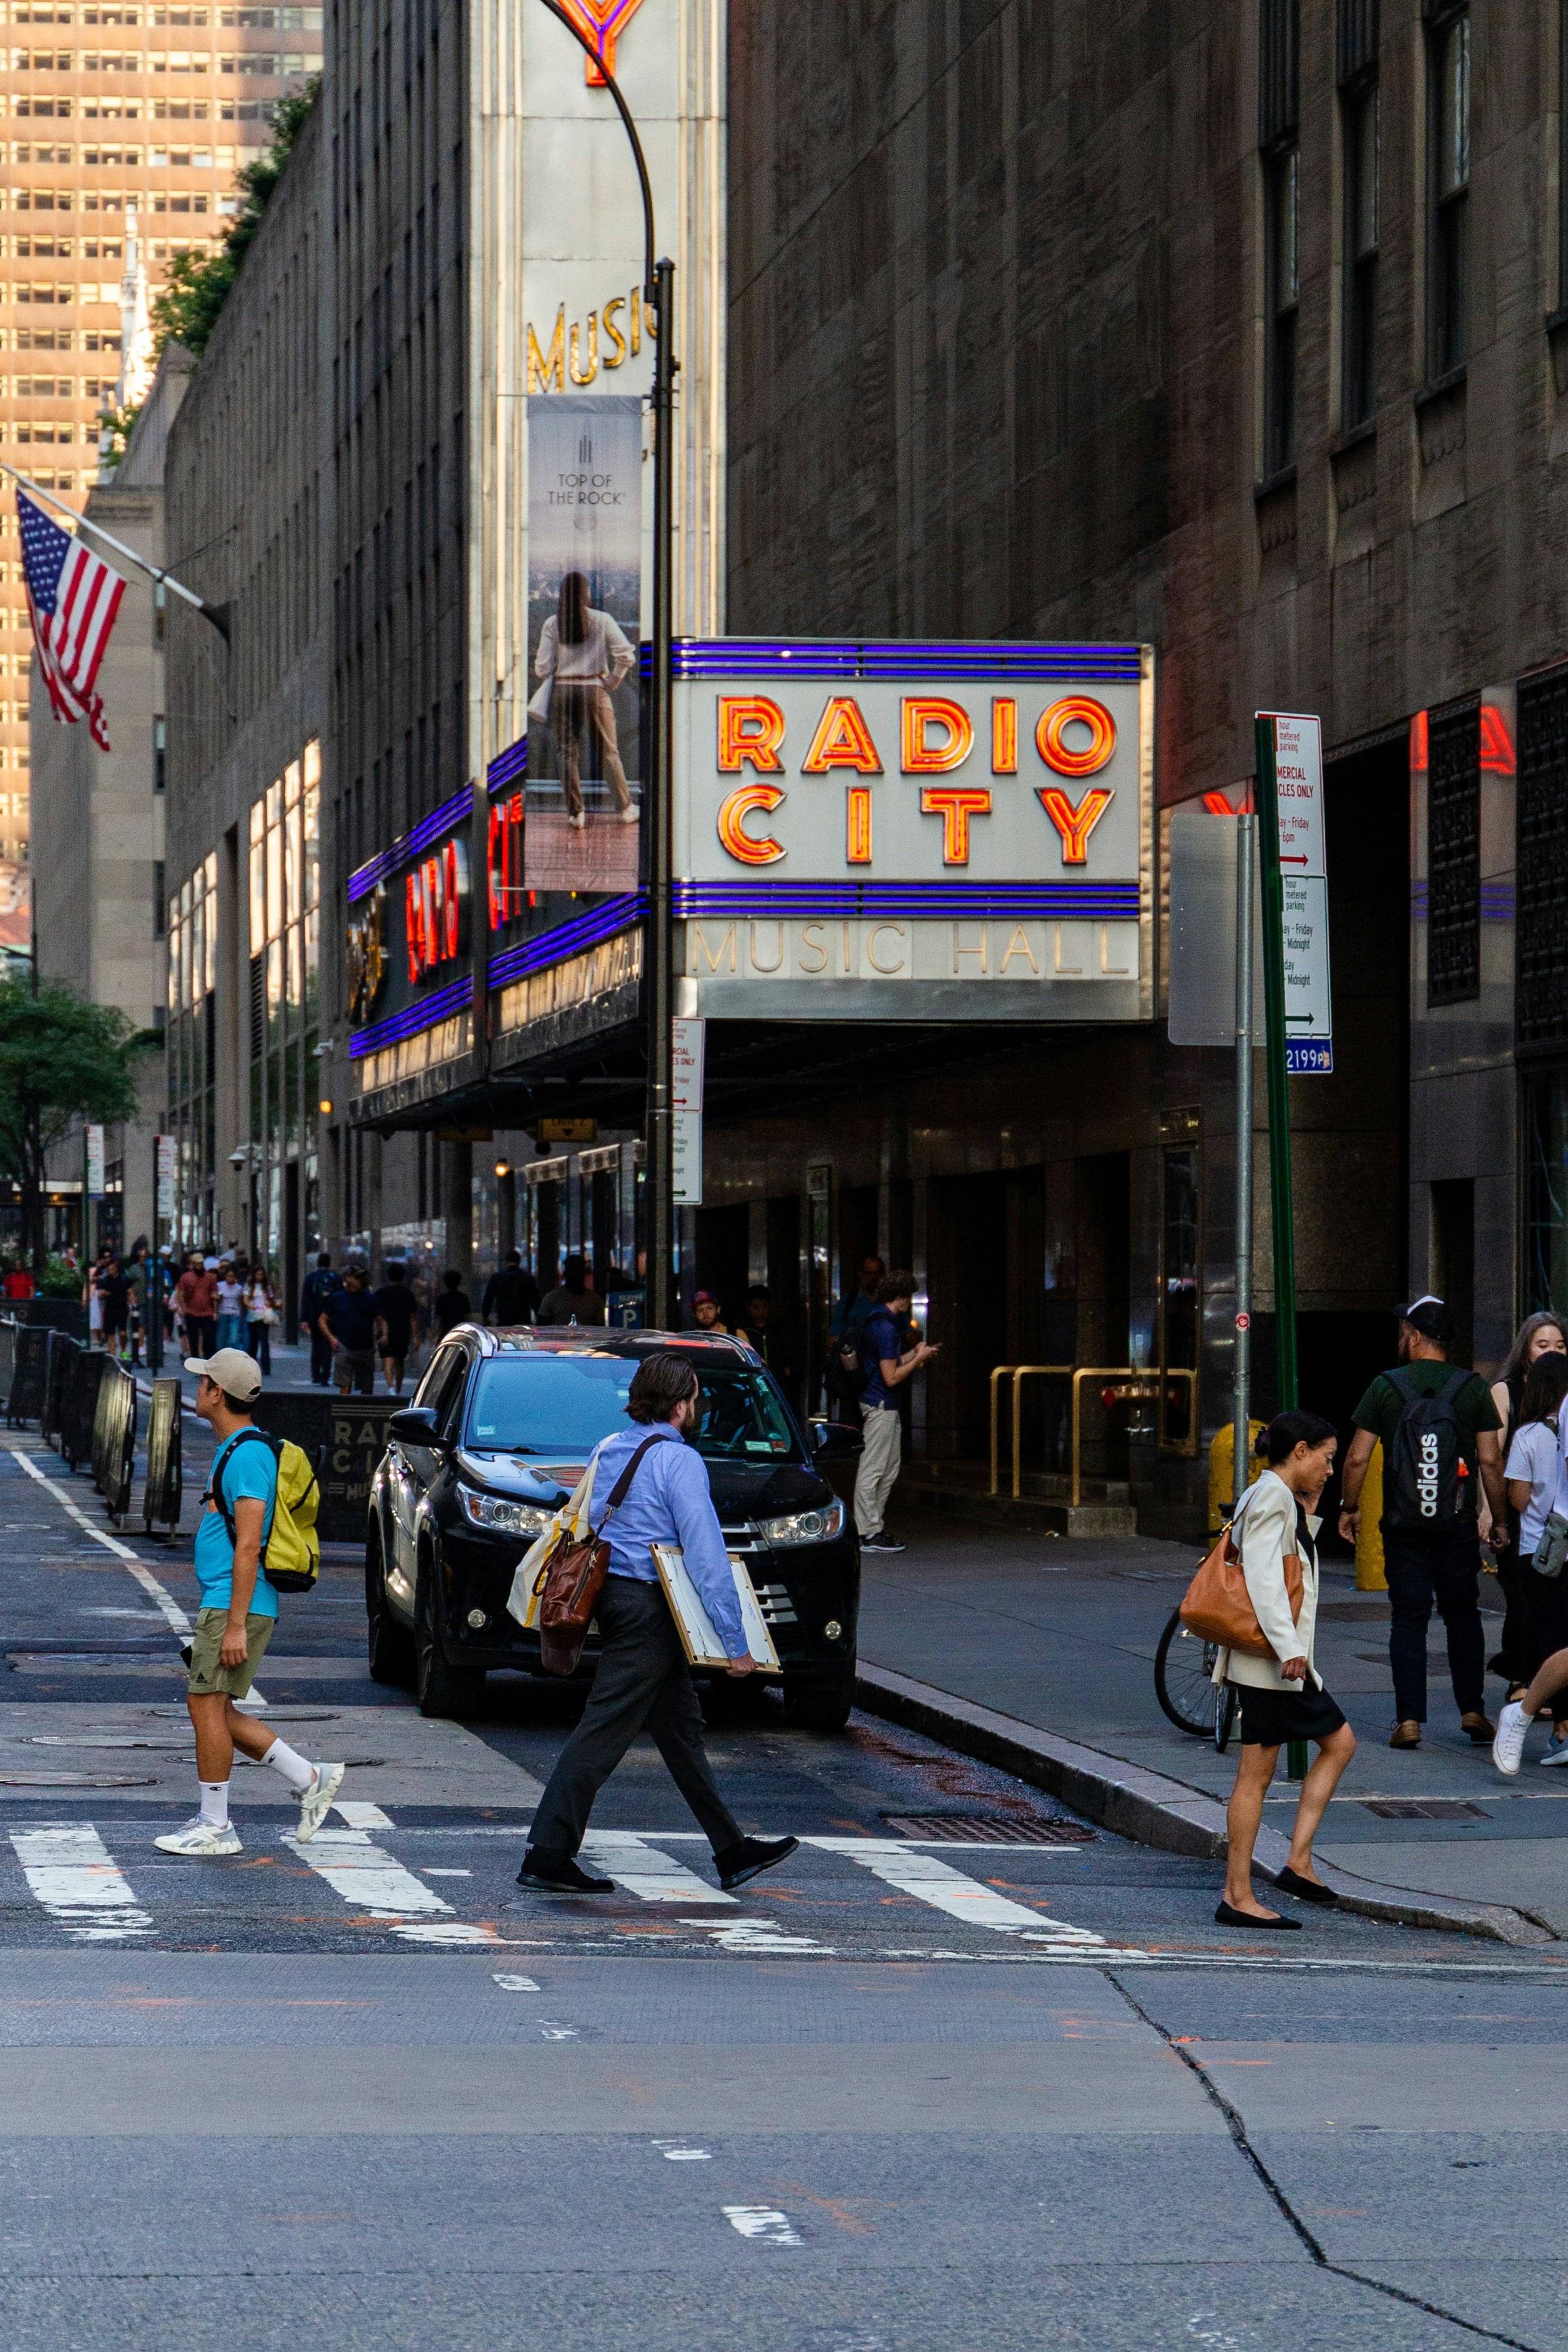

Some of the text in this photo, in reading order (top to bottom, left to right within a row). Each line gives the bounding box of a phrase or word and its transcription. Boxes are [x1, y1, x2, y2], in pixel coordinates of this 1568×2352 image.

[557, 474, 613, 487] TOP OF
[548, 491, 574, 504] THE
[1279, 720, 1290, 730] hour
[716, 694, 1117, 778] RADIO
[1279, 732, 1300, 742] metered
[1280, 742, 1298, 753] parking
[1296, 785, 1314, 798] ONLY
[716, 783, 1117, 866] CITY
[1292, 817, 1310, 831] Friday
[1282, 833, 1295, 844] 6pm
[1285, 879, 1297, 889] hour
[1286, 890, 1306, 900] metered
[1286, 902, 1305, 912] parking
[1296, 923, 1313, 937] Friday
[691, 922, 1128, 975] MUSIC HALL
[1287, 938, 1310, 952] Midnight
[1283, 960, 1295, 971] day
[1288, 974, 1311, 988] Midnight
[1287, 1049, 1316, 1068] 2199
[623, 1309, 637, 1329] P
[1417, 1433, 1438, 1517] adidas
[346, 1481, 371, 1501] MU
